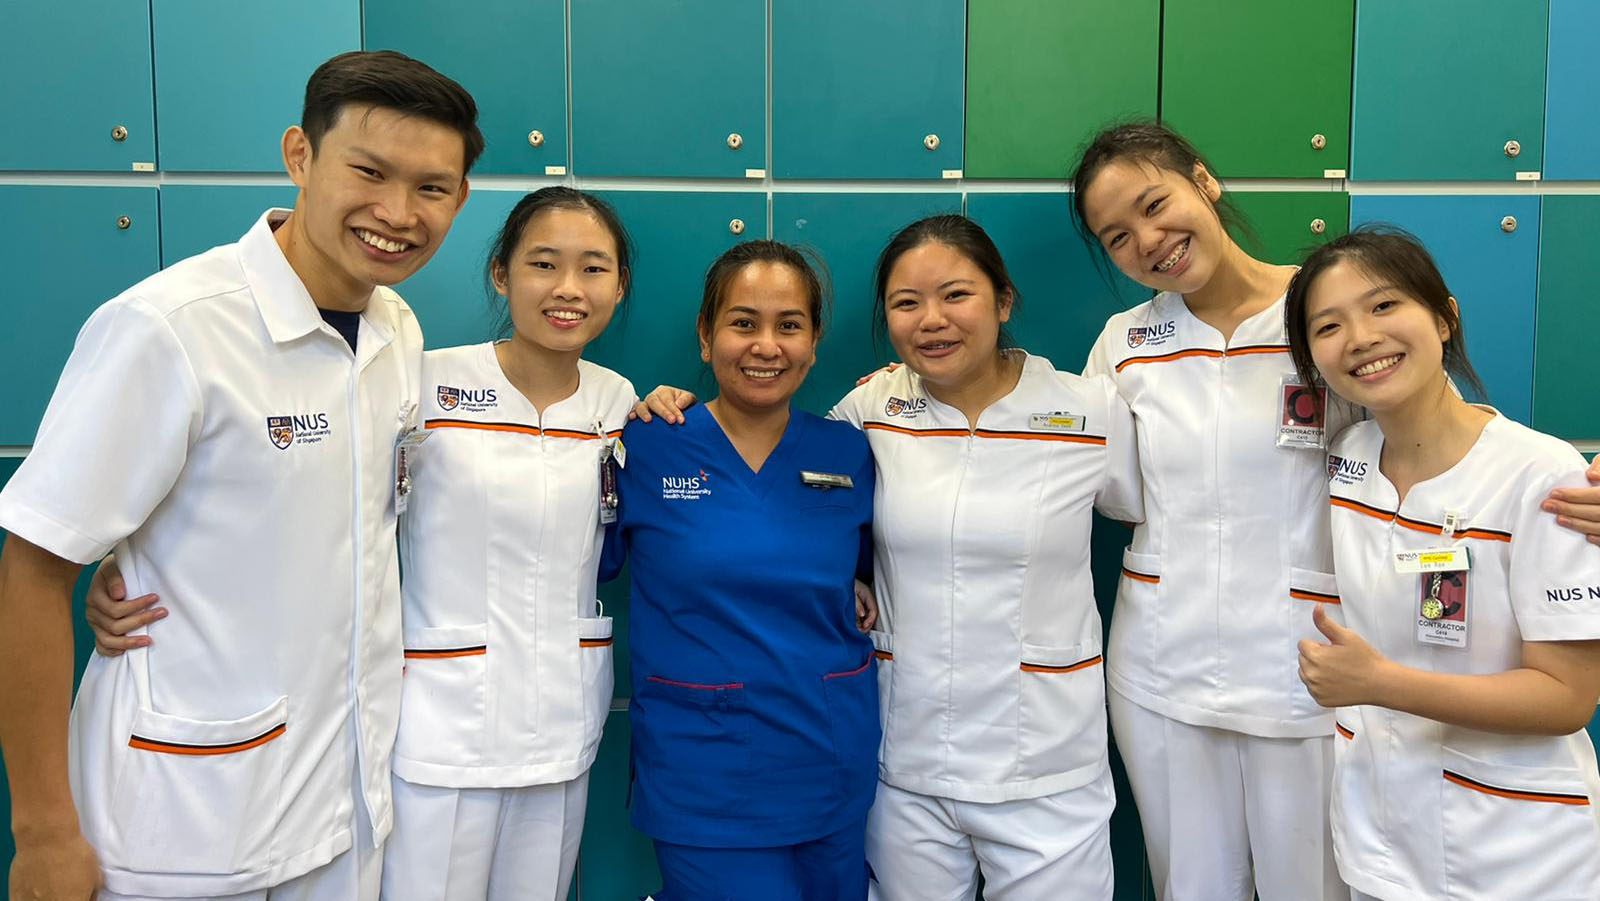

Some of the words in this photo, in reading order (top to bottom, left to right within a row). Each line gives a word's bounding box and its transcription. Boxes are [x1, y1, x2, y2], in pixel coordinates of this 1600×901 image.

[1147, 320, 1175, 337] NUS
[461, 389, 497, 402] NUS
[904, 398, 927, 410] NUS
[293, 413, 329, 431] NUS
[313, 429, 331, 437] University
[1340, 458, 1368, 476] NUS
[662, 476, 700, 489] NUHS
[1546, 588, 1583, 602] NUS
[1588, 586, 1600, 600] N
[1418, 620, 1466, 633] CONTRACTOR
